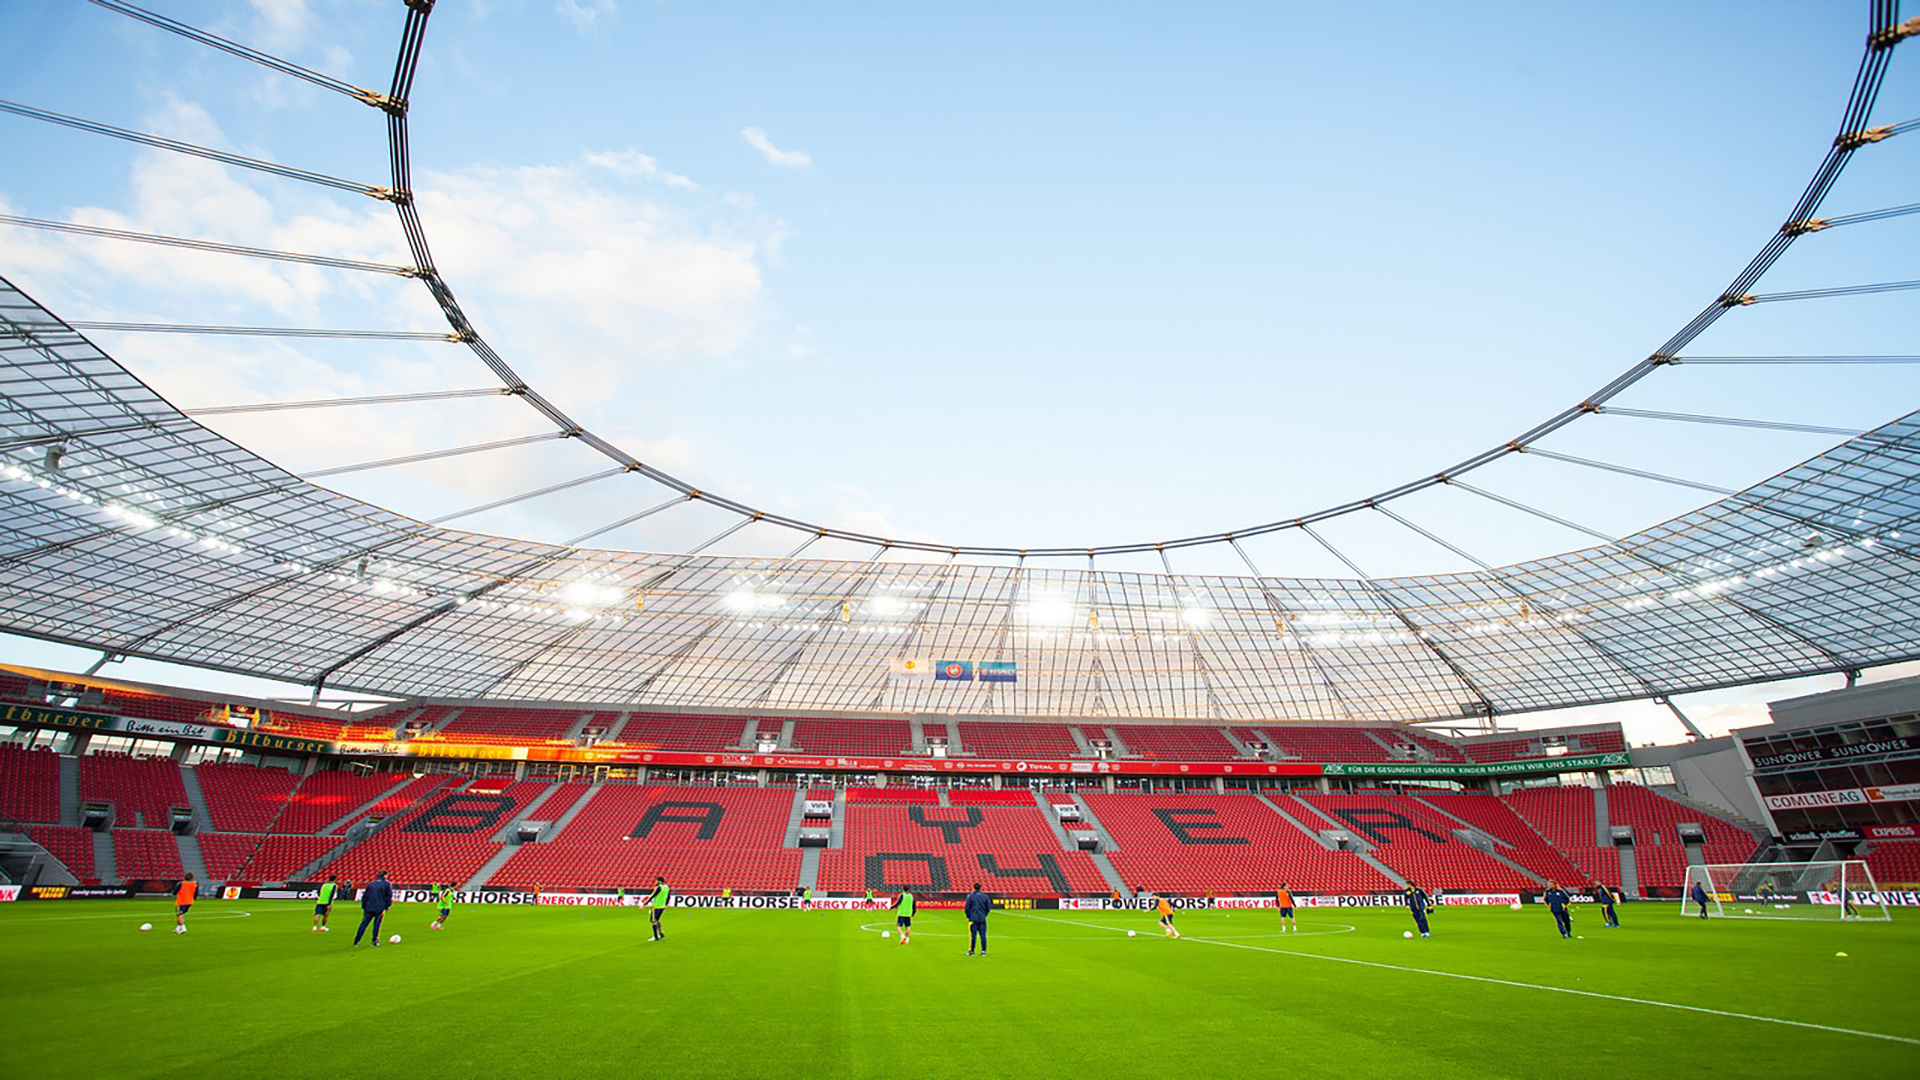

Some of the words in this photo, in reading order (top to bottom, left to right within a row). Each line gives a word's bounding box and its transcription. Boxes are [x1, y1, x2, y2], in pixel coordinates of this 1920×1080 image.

[159, 726, 180, 734] ein
[225, 730, 325, 752] Bitburger
[1754, 750, 1823, 767] SUNPOWER
[1831, 739, 1911, 757] SUNPOWER
[1488, 764, 1525, 773] MACHEN
[1527, 762, 1544, 770] WIR
[1567, 759, 1599, 767] STARK!
[1872, 826, 1915, 837] EXPRESS
[471, 891, 531, 904] HORSE
[739, 896, 799, 909] HORSE
[1338, 895, 1389, 907] POWER
[1445, 897, 1483, 905] ENERGY
[1487, 896, 1518, 905] DRINK
[1217, 899, 1260, 909] ENERGY
